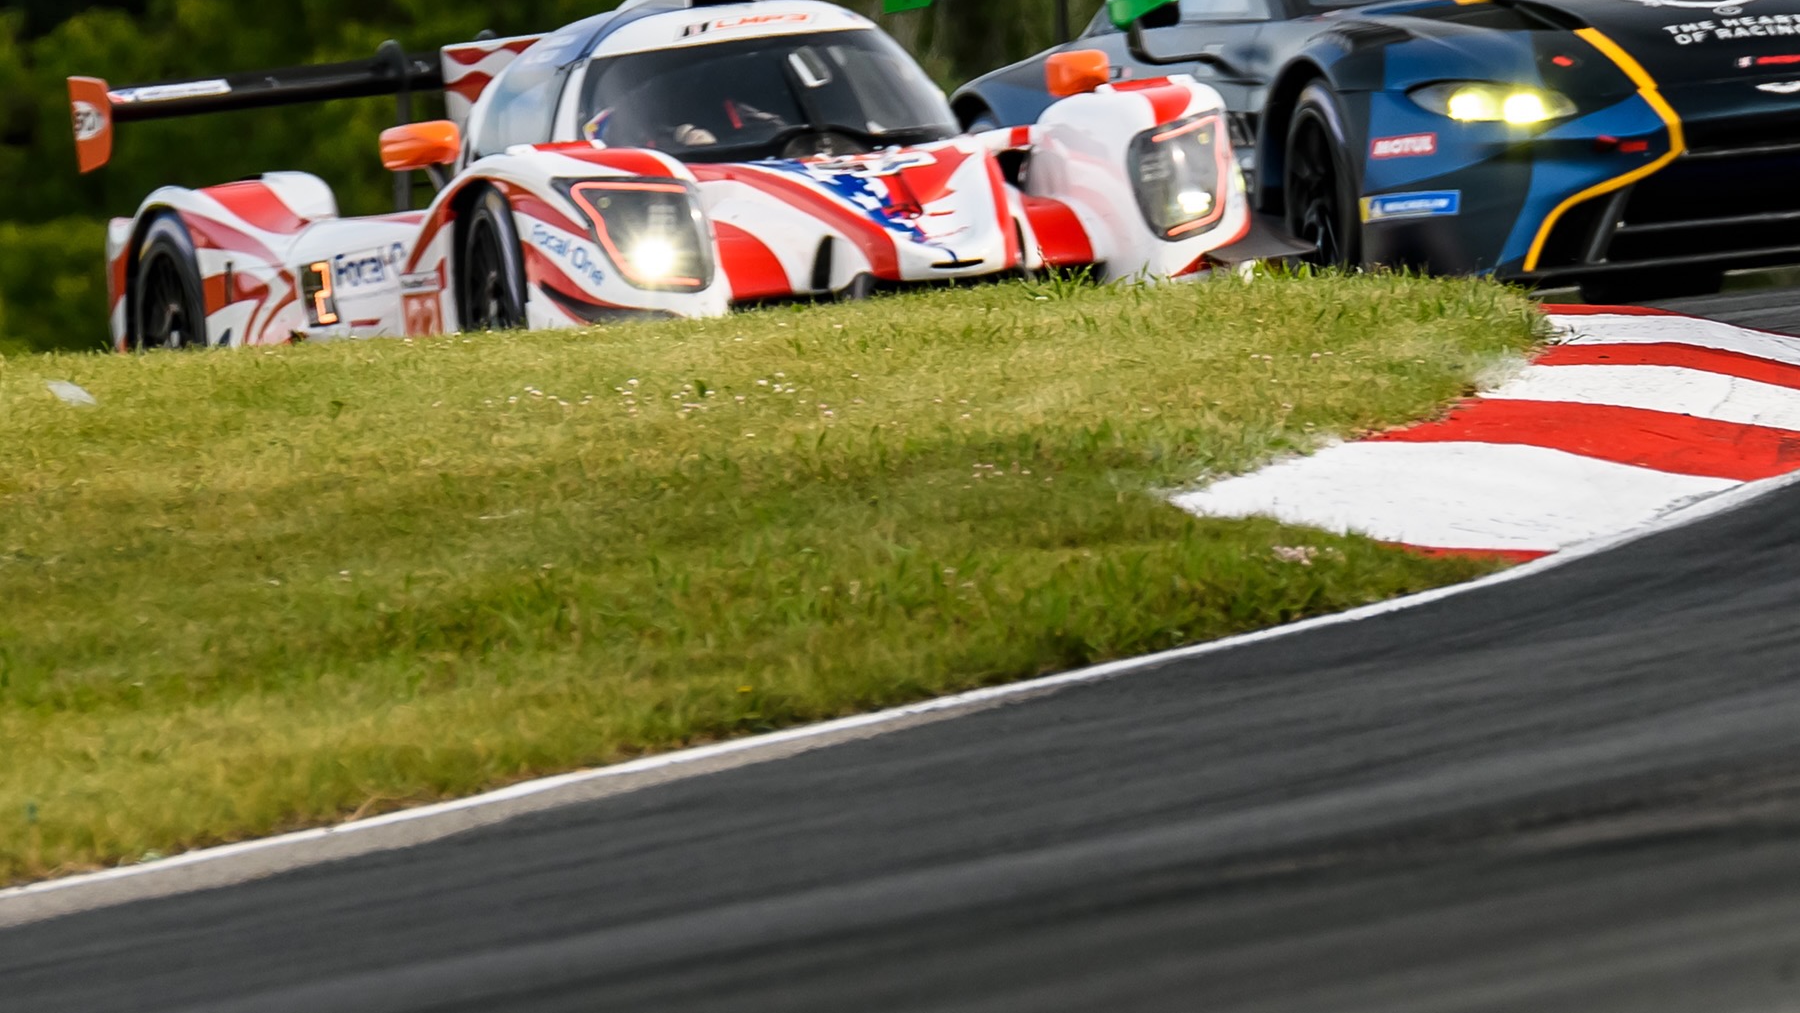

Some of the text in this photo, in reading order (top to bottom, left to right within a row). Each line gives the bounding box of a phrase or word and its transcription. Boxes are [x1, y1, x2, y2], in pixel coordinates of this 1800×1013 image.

[1662, 19, 1716, 34] THE
[1674, 30, 1708, 45] OF
[1373, 135, 1434, 155] MOTUL
[311, 261, 338, 325] 2
